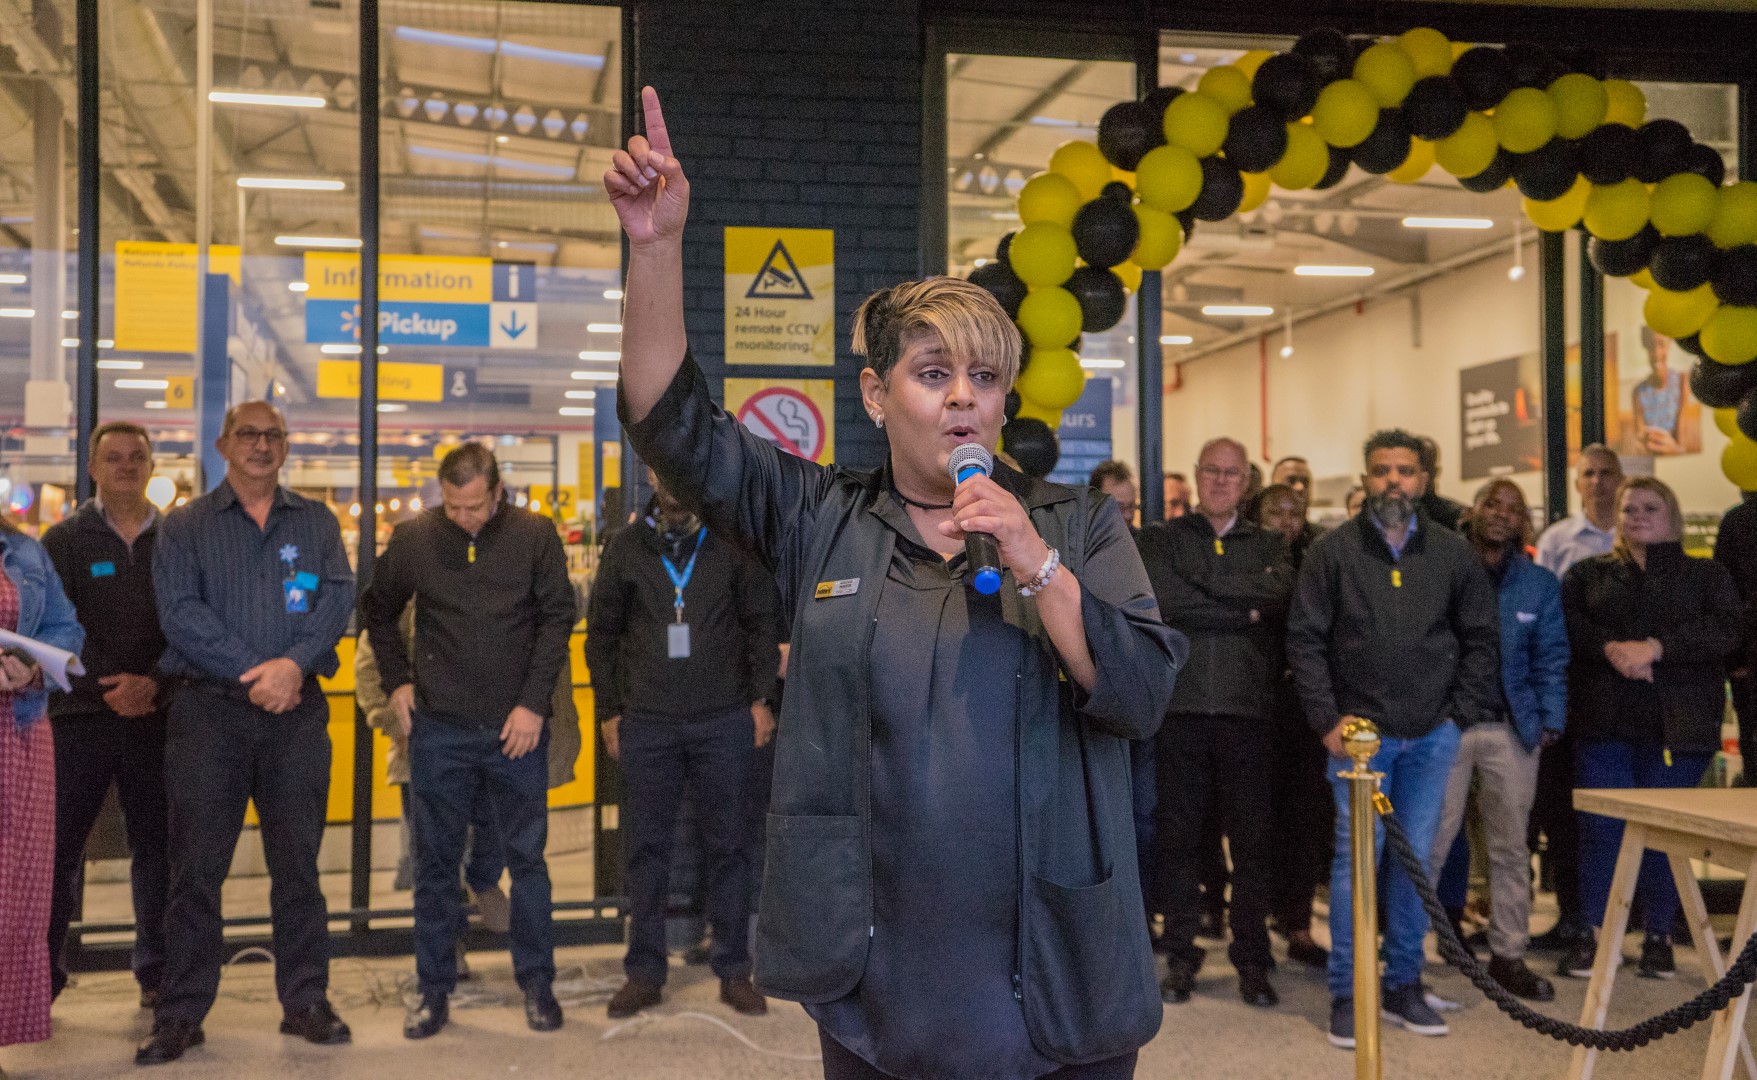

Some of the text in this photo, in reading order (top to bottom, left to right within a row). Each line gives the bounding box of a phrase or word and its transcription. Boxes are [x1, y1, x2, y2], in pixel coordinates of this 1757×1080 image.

[324, 267, 473, 290] Infmation
[735, 306, 787, 319] 24 Hour
[377, 311, 458, 341] Pickup
[735, 322, 820, 335] remote CCTV
